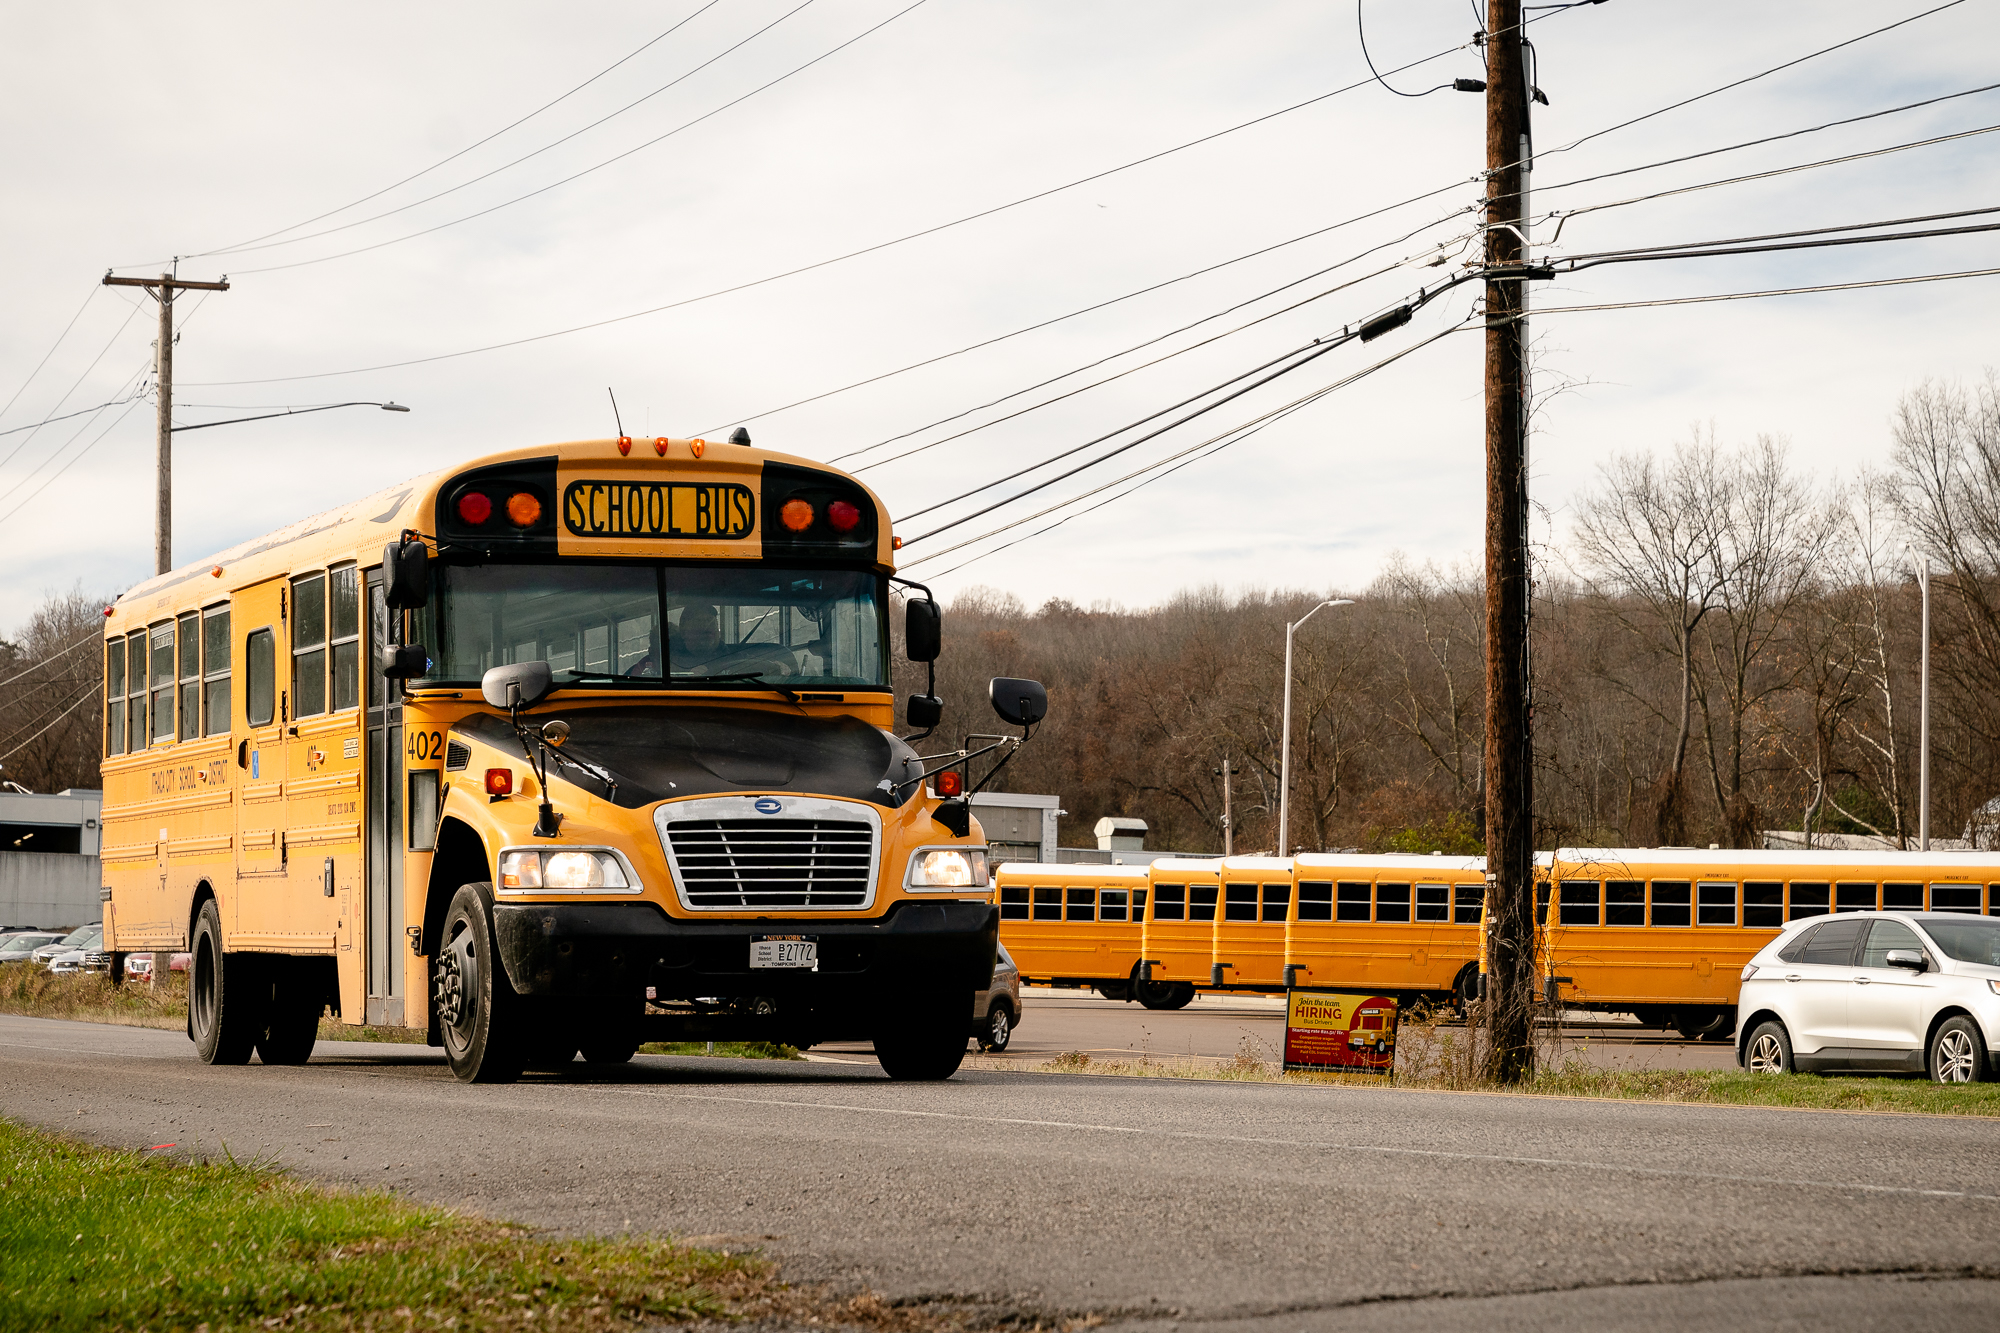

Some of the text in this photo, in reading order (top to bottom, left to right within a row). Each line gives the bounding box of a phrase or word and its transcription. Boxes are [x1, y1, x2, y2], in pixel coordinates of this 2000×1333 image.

[570, 485, 749, 535] SCHOOL BUS
[408, 731, 443, 760] 402
[152, 771, 165, 795] ITHACA
[166, 769, 176, 793] CITY
[179, 765, 196, 790] SCHOOL
[209, 759, 228, 785] DISTRICT
[1295, 1006, 1342, 1019] HIRING
[1298, 998, 1313, 1007] Join
